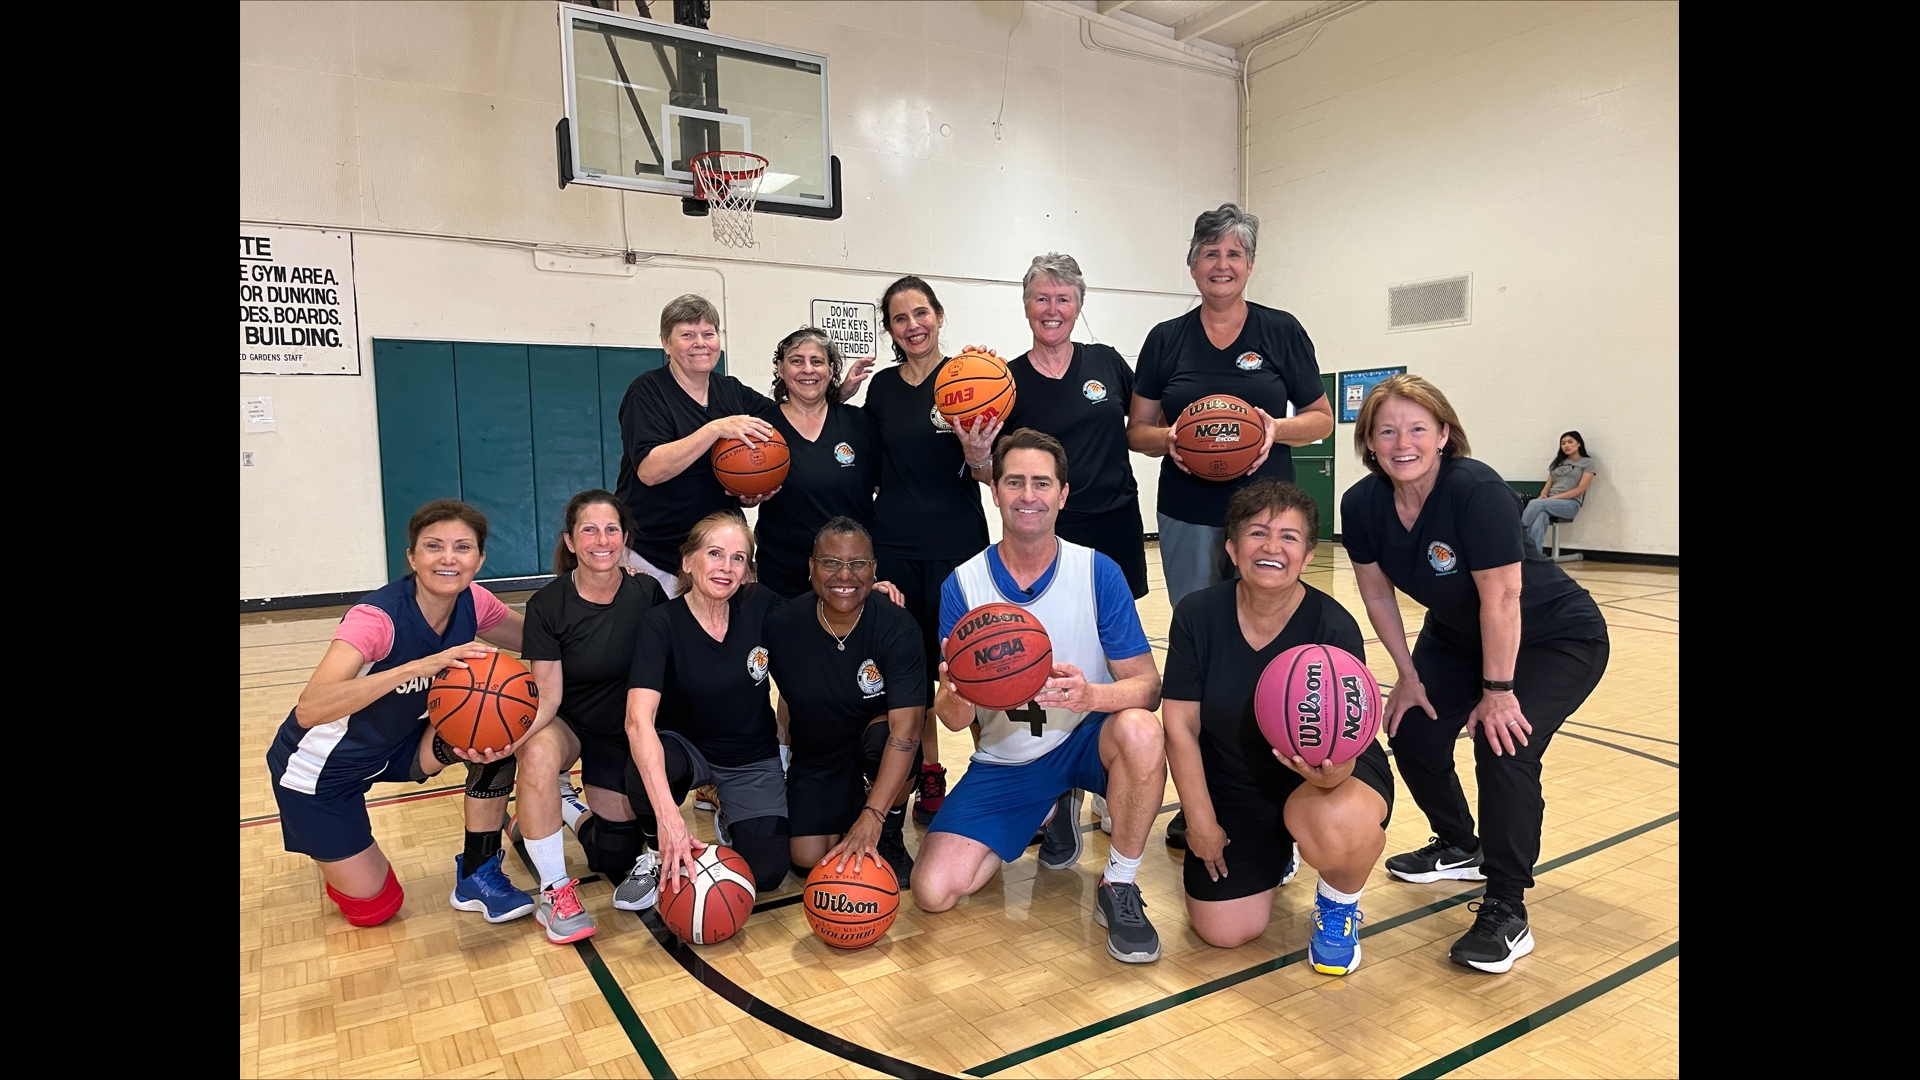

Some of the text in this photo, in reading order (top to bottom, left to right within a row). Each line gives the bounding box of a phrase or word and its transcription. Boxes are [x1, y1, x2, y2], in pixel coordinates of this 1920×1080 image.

[240, 236, 271, 257] TE
[252, 265, 287, 283] GYM
[290, 267, 339, 286] AREA.
[240, 285, 340, 305] OR DUNKING.
[274, 307, 342, 325] BOARDS.
[830, 306, 859, 318] DO NOT
[822, 318, 868, 331] LEAVE KEYS
[245, 326, 343, 348] BUILDING.
[829, 330, 874, 343] VALUABLES
[835, 342, 869, 354] TTENDED
[1188, 399, 1248, 416] Wilson
[1194, 422, 1240, 438] NCAA
[956, 612, 1027, 641] Wilson
[973, 638, 1026, 667] NCAA
[395, 675, 436, 694] SAN
[1298, 662, 1323, 748] Wilson
[1341, 675, 1363, 741] NCAA
[1004, 699, 1047, 738] 4
[813, 889, 879, 914] Wilson
[814, 923, 876, 941] EVOLUTION
